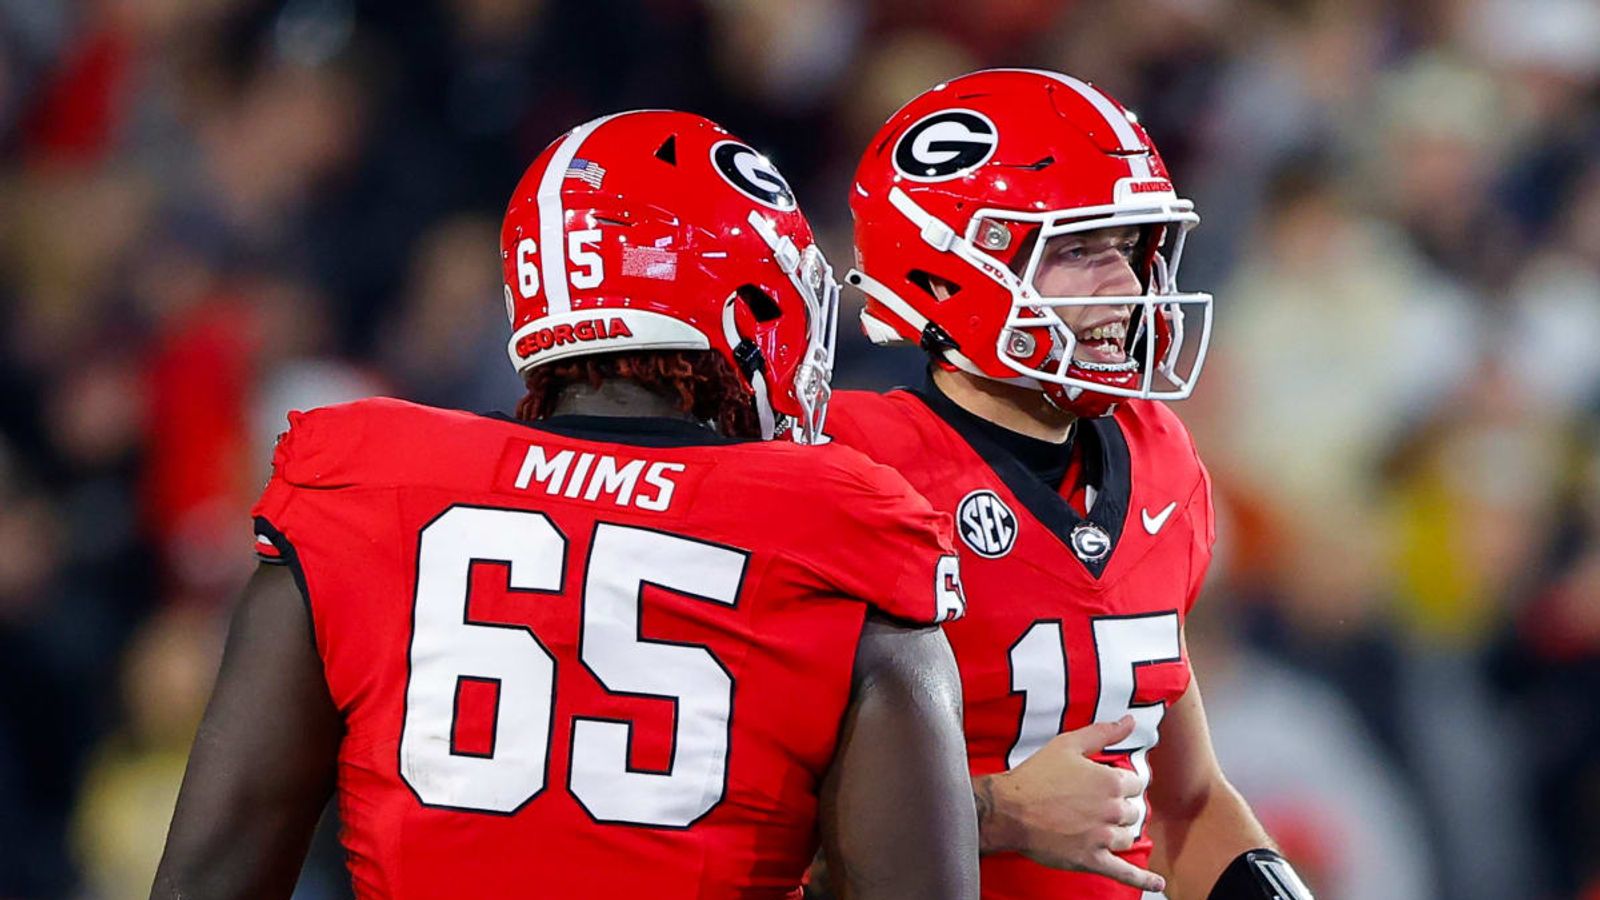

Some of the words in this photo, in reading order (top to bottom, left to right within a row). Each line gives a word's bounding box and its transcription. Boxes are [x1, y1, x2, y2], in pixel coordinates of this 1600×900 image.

[515, 317, 633, 358] GEORGIA
[514, 444, 686, 512] MIMS
[962, 494, 1013, 553] SEC
[934, 554, 967, 623] 6
[398, 501, 752, 829] 65
[1007, 608, 1182, 842] 15
